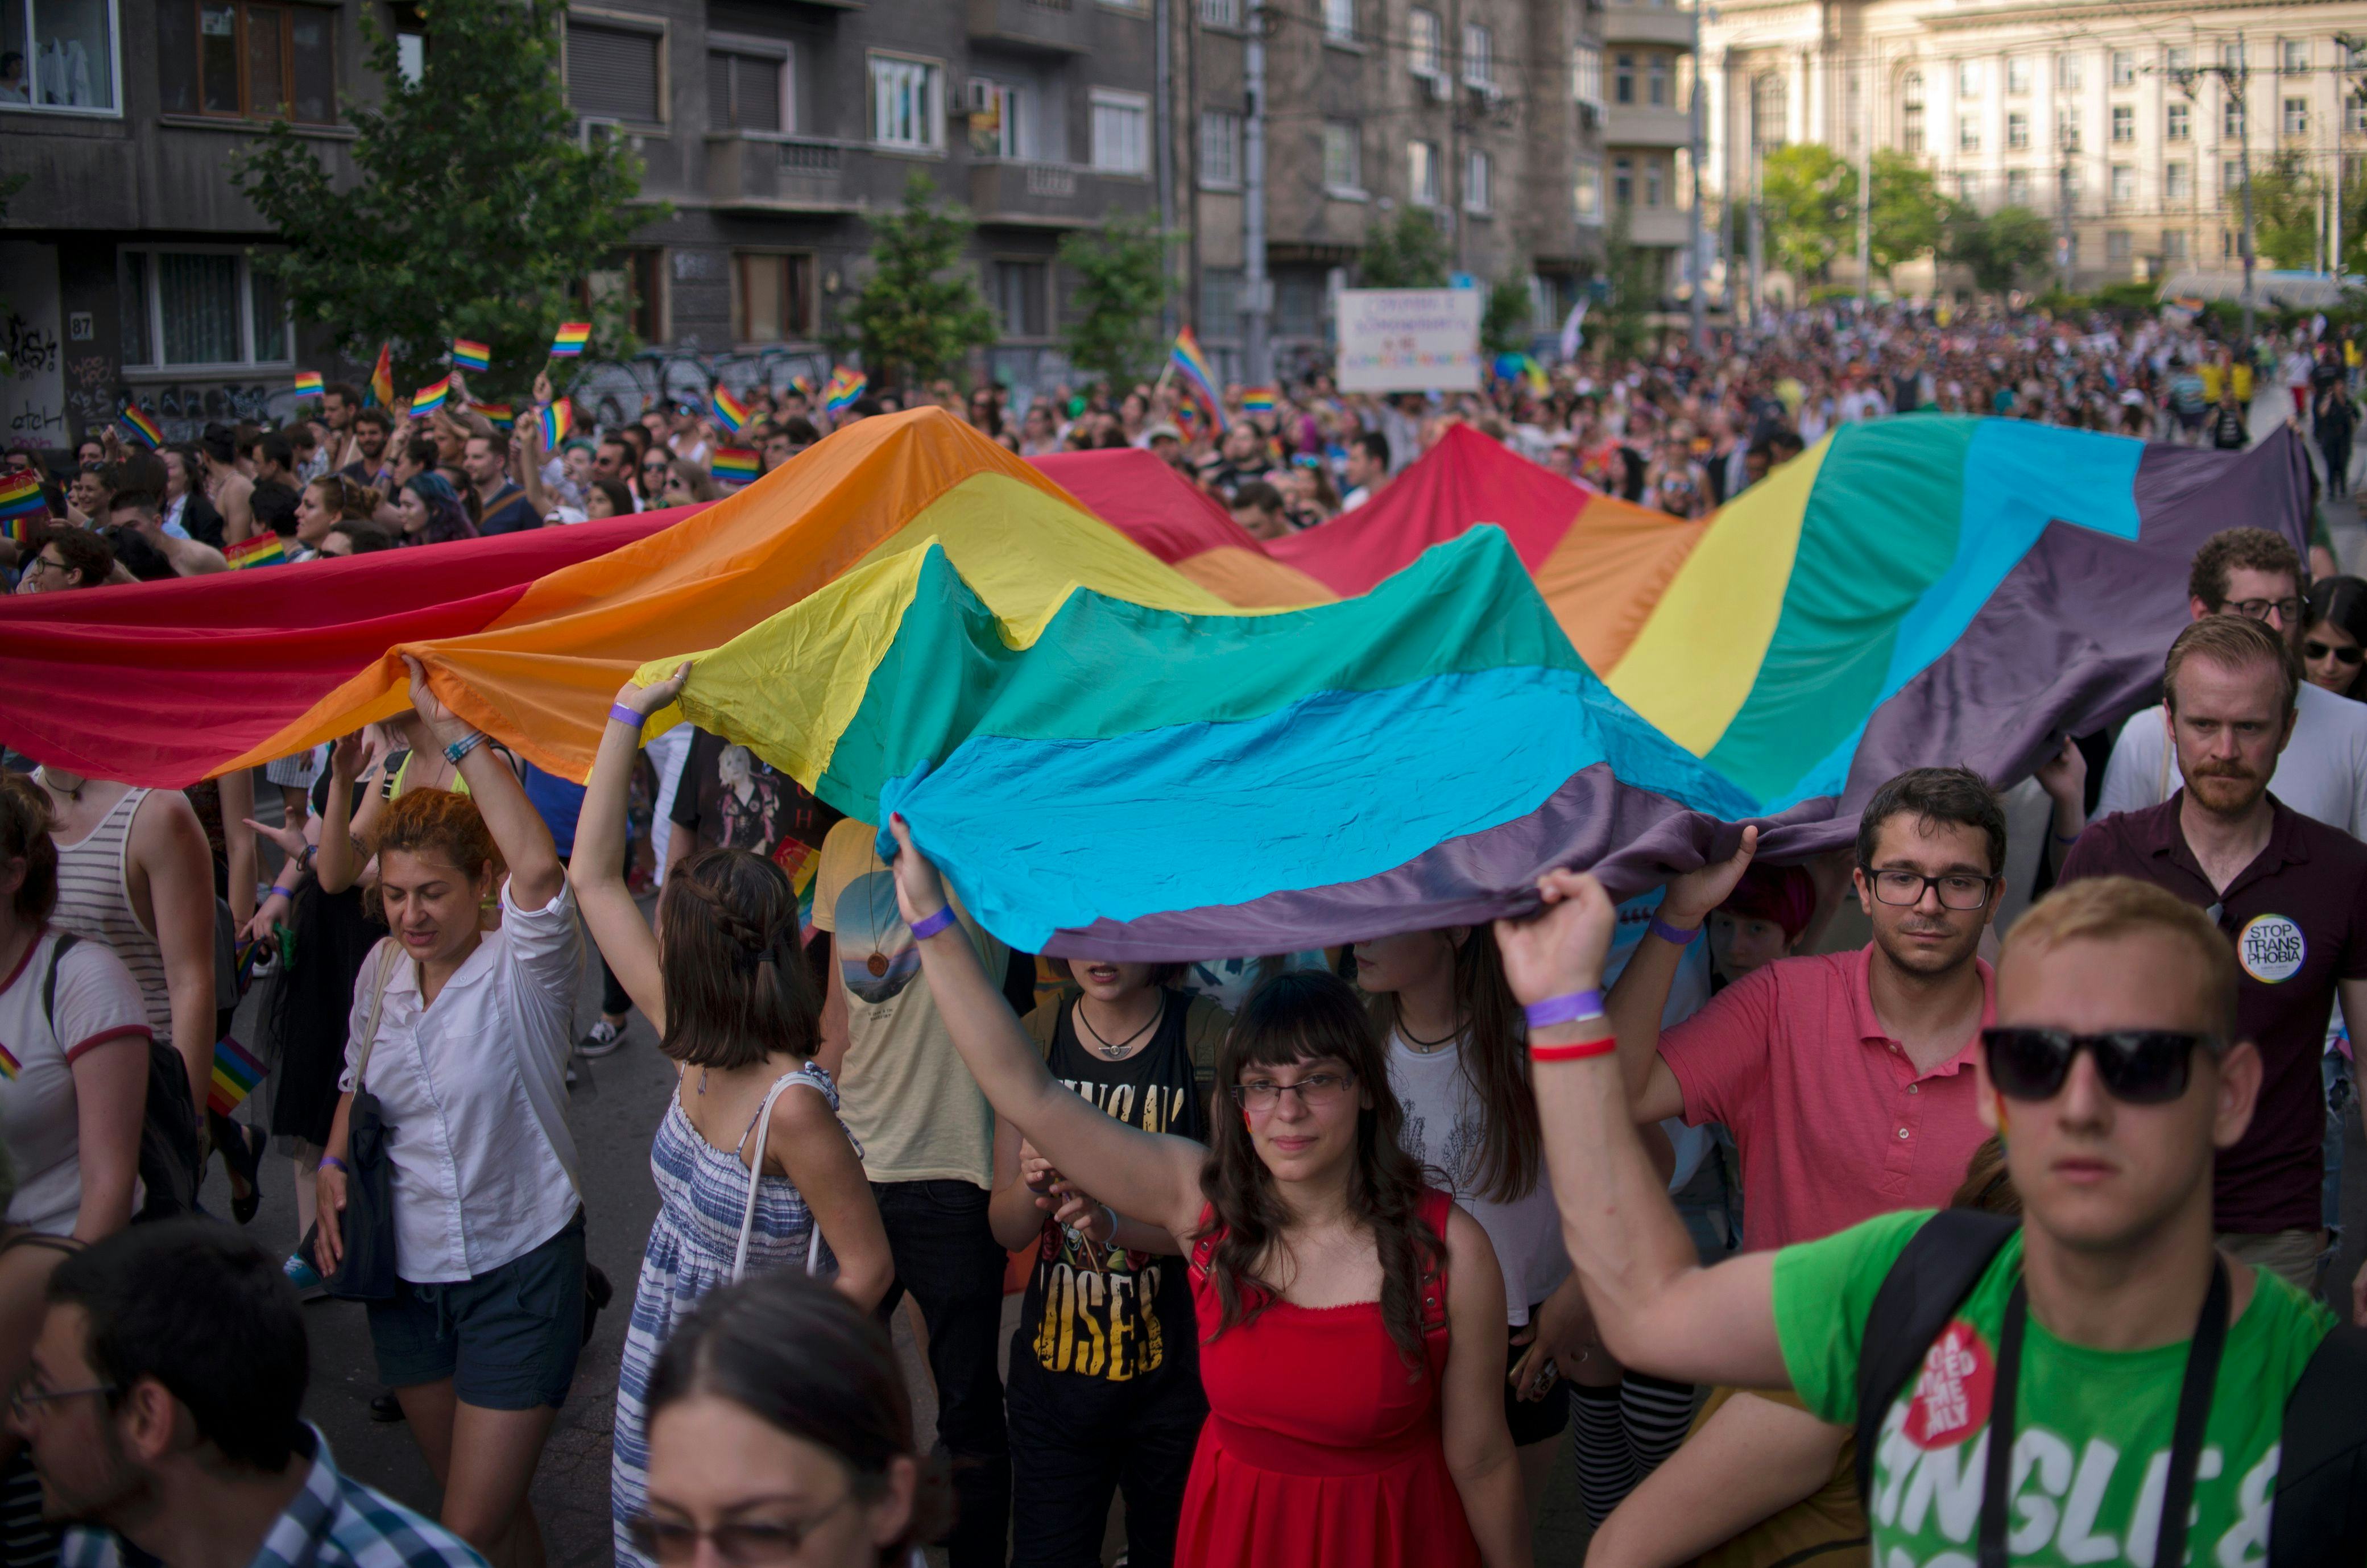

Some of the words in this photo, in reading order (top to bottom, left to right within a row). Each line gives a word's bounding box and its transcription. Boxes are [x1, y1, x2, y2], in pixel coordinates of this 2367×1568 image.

[72, 319, 90, 334] 87
[2250, 924, 2292, 939] STOP
[2244, 936, 2300, 953] TRANS
[2247, 950, 2301, 965] PHOBIA
[1033, 1262, 1164, 1382] OSES
